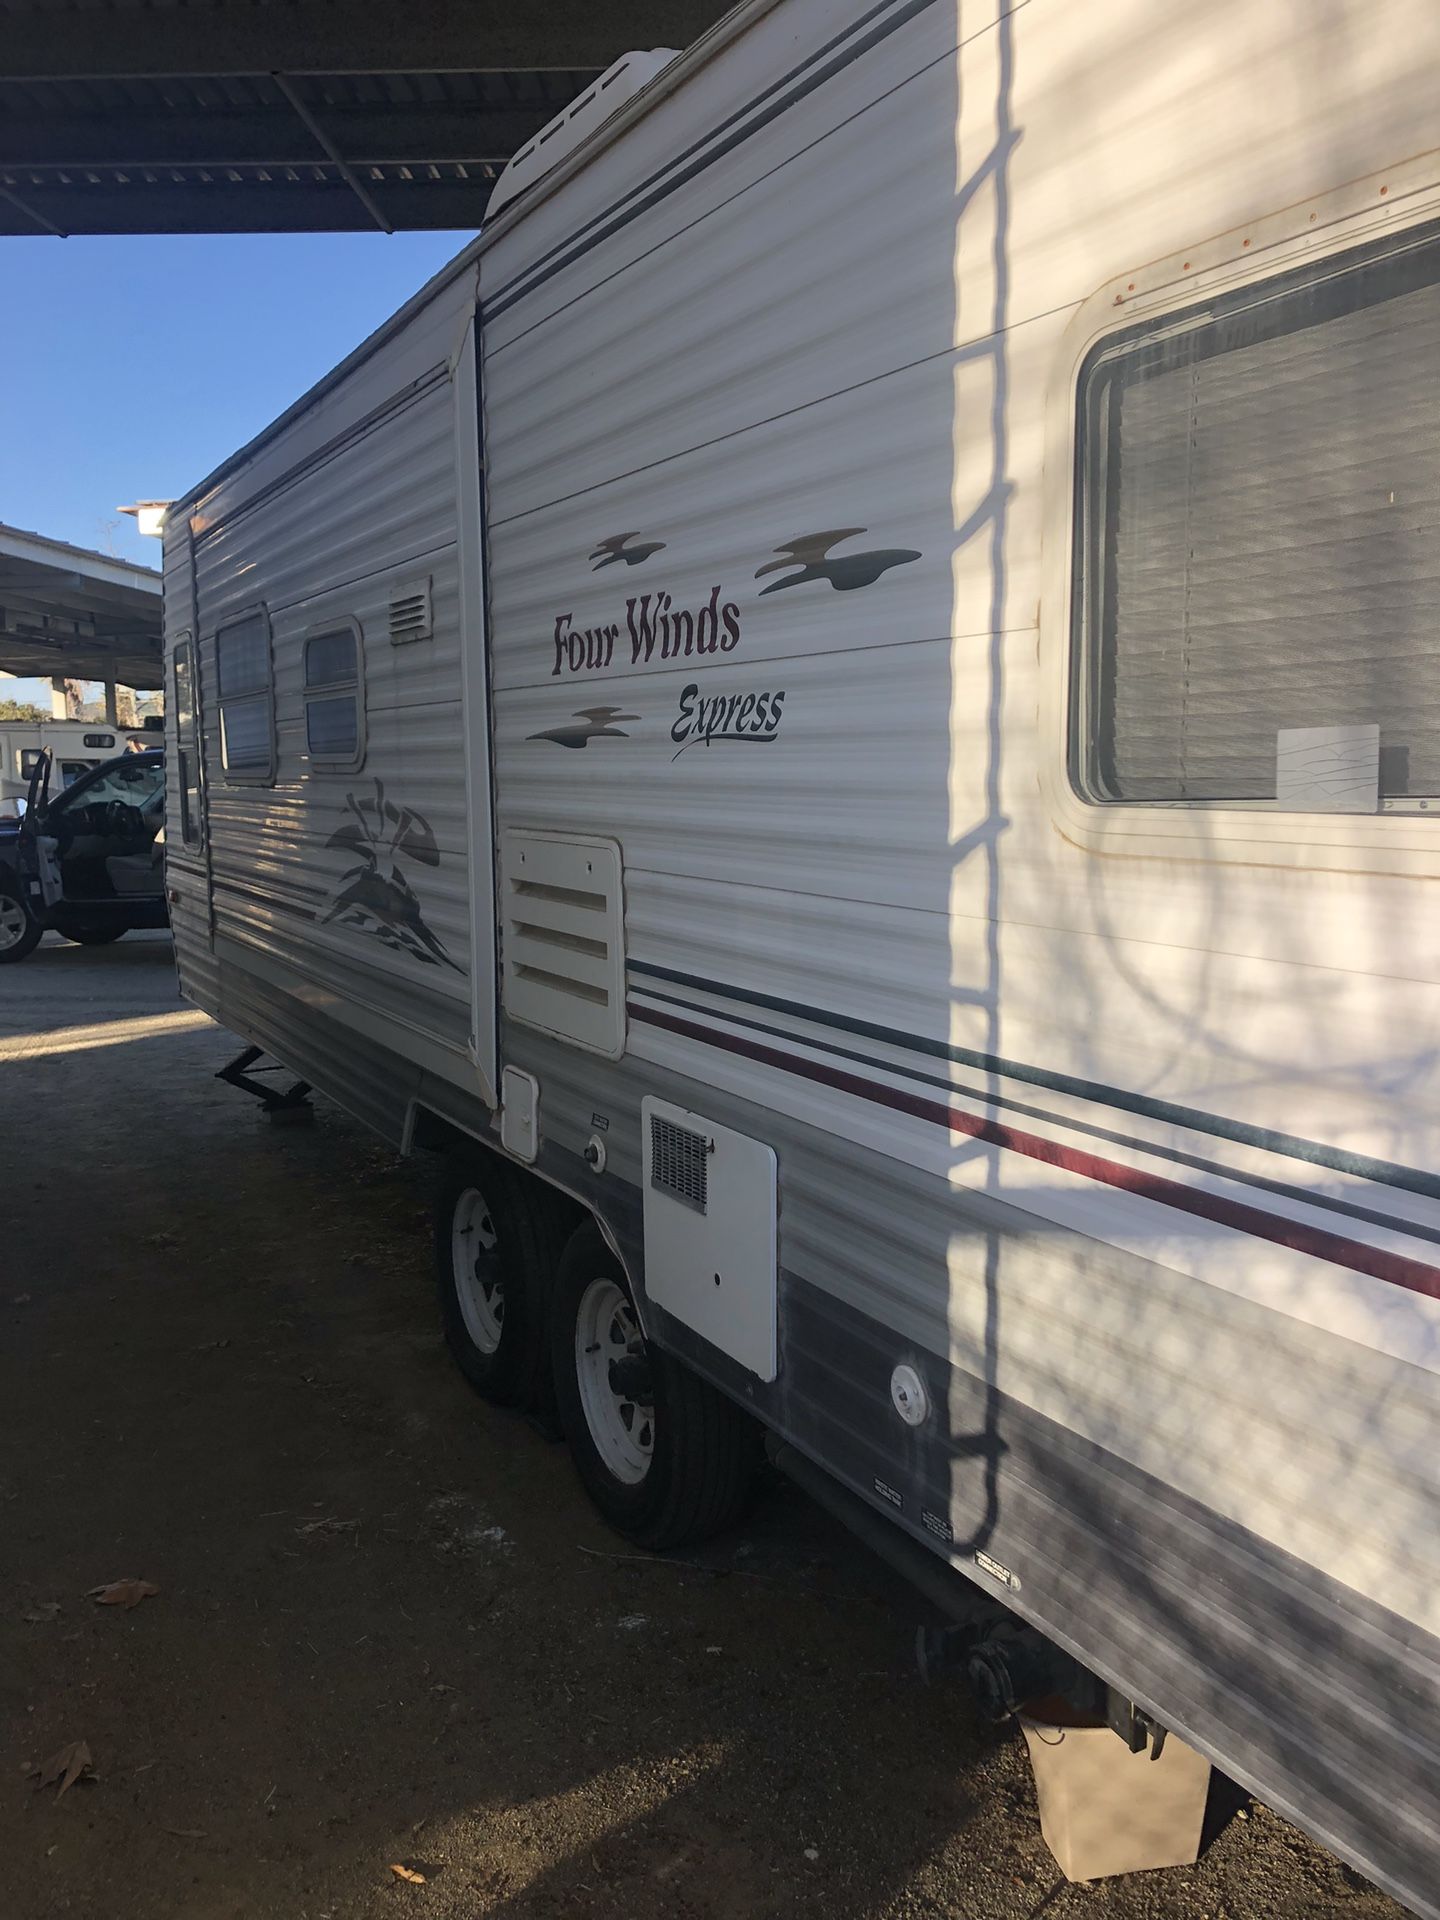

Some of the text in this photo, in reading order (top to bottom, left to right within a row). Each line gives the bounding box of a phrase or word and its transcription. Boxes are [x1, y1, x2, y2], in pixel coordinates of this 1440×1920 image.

[552, 584, 741, 676] Four Winds
[670, 683, 786, 748] Express
